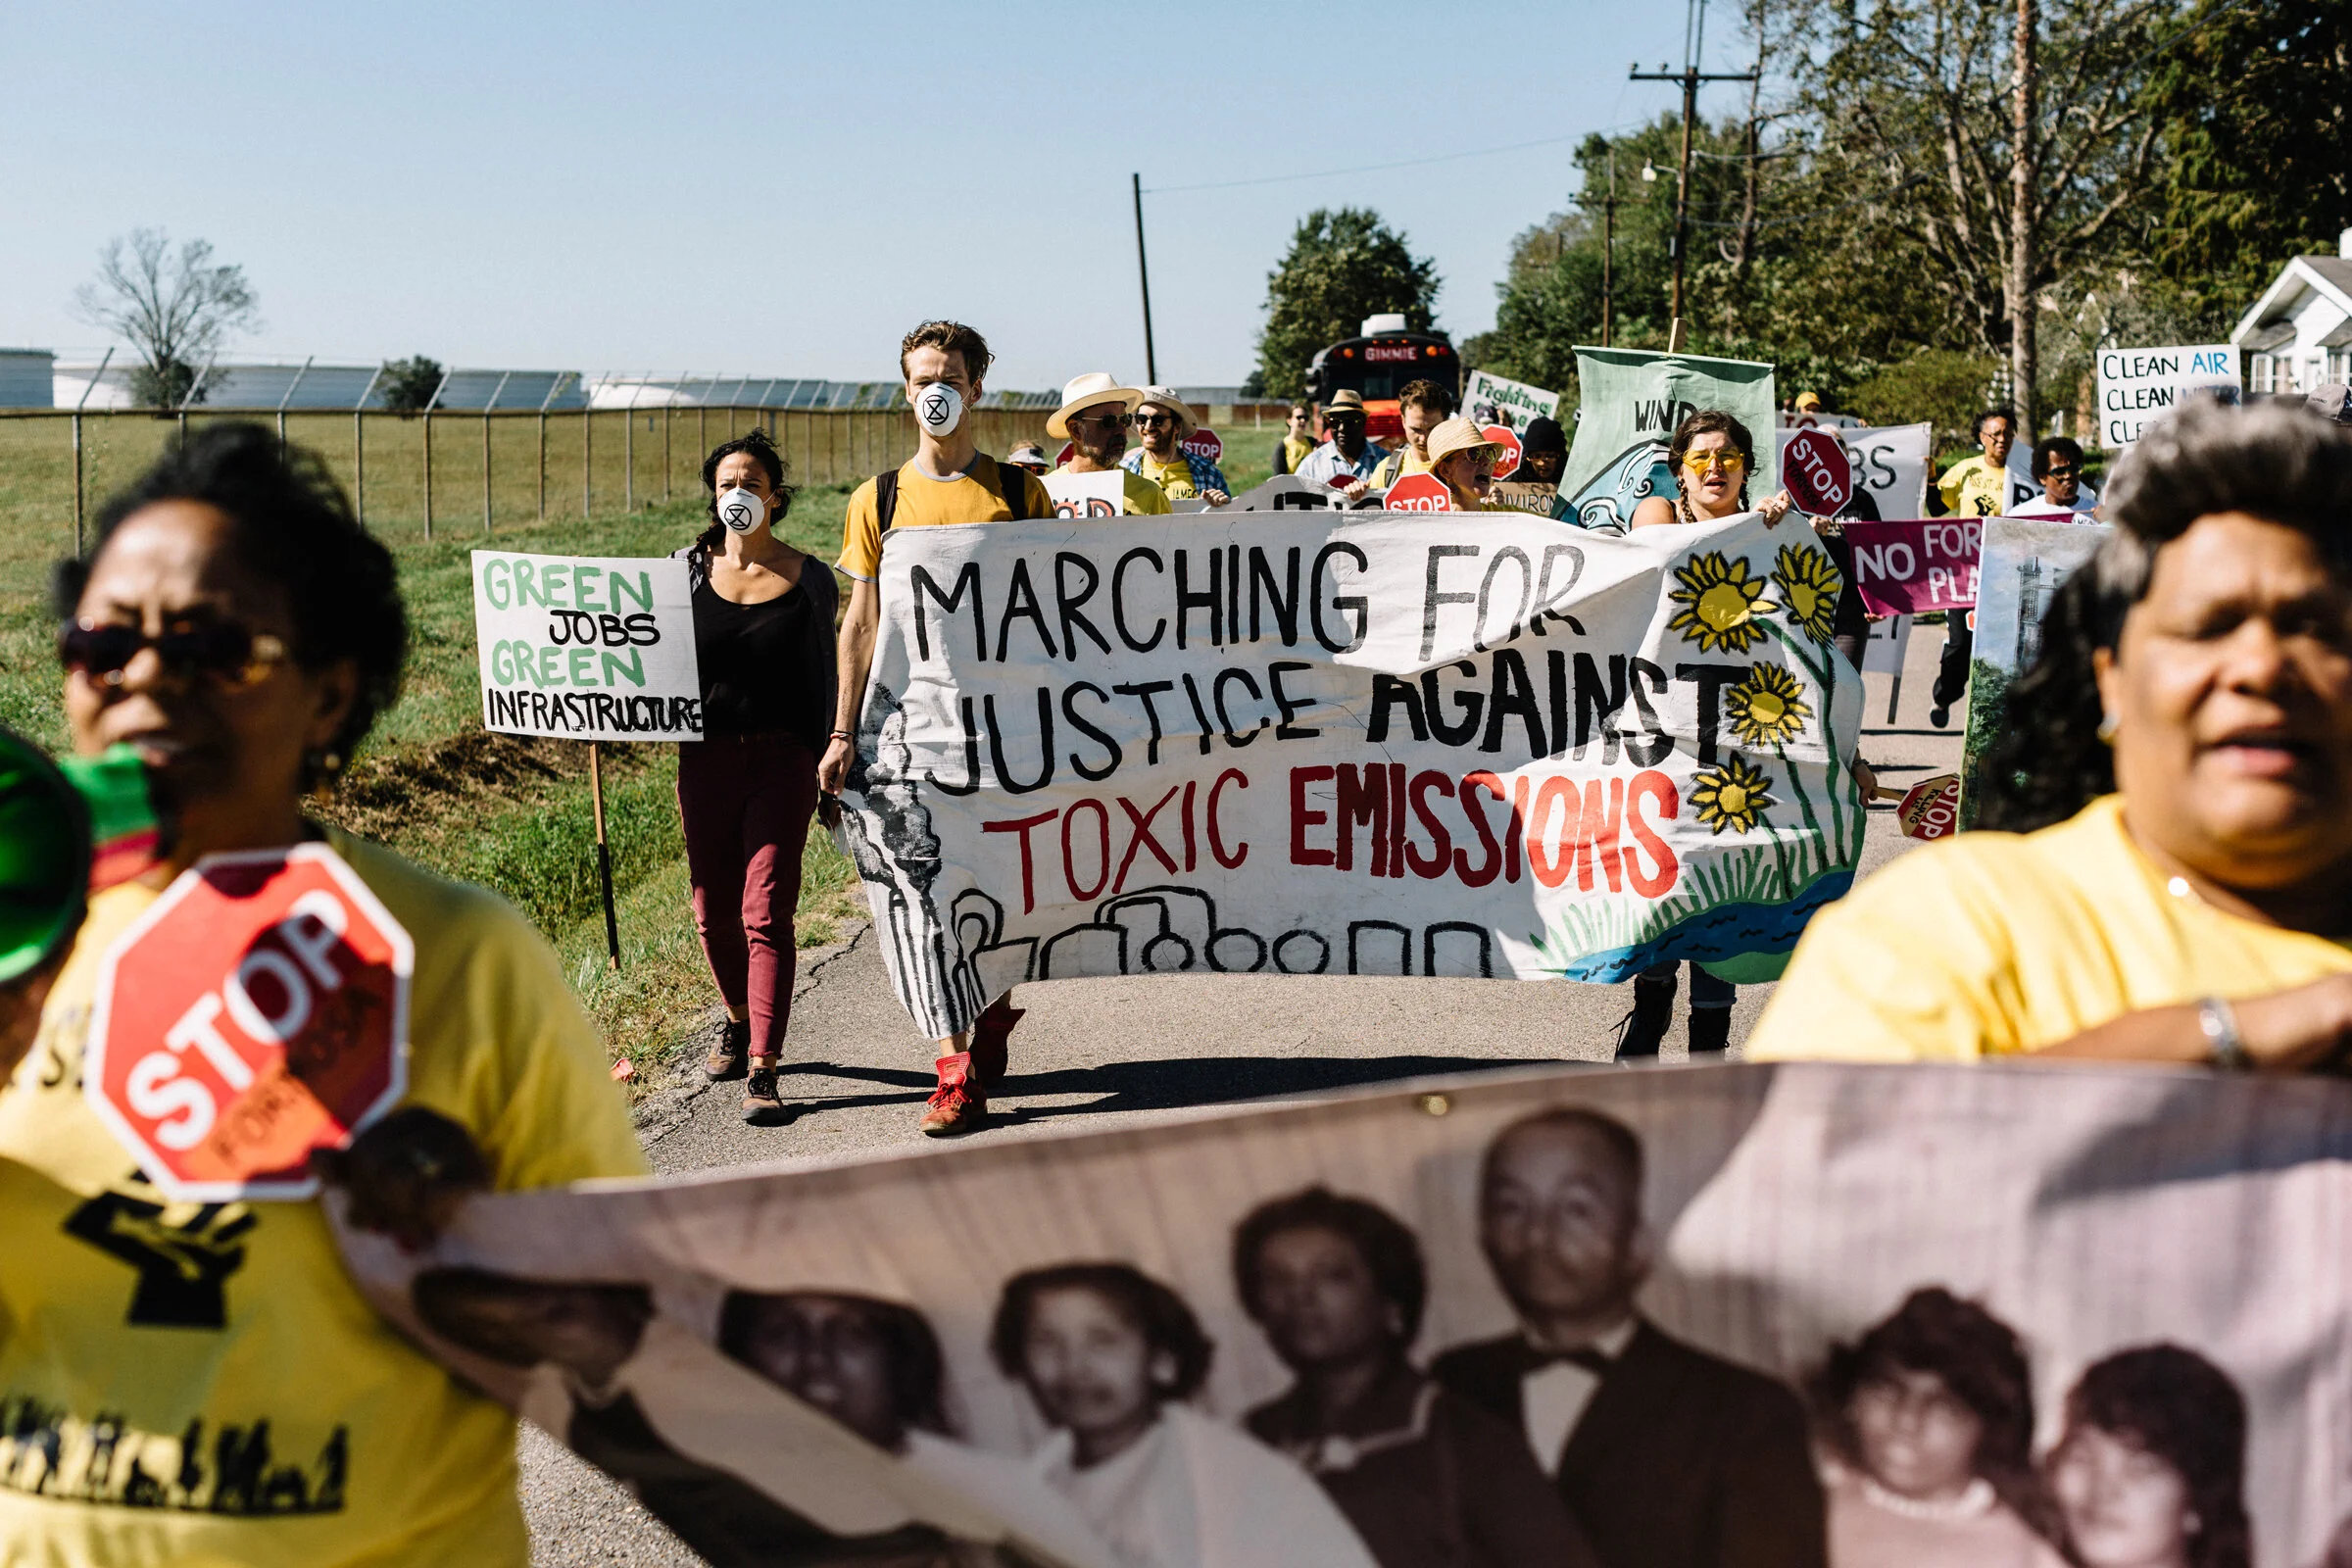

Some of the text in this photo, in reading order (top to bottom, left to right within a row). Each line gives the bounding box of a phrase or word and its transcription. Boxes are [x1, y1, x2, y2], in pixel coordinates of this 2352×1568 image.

[1365, 347, 1417, 361] GINNIE
[2103, 352, 2230, 380] CLEAN AIR
[1477, 377, 1553, 416] Fighting
[1635, 400, 1698, 432] WIND
[2107, 386, 2174, 412] CLEAN
[1184, 442, 1220, 459] STOP
[2110, 420, 2145, 444] CLE
[1792, 438, 1843, 504] STOP
[1390, 494, 1447, 513] STOP
[1854, 542, 1916, 583] NO
[483, 559, 654, 615] GREEN
[909, 541, 1588, 662] MARCHING FOR
[549, 610, 662, 647] JOBS
[492, 639, 646, 689] GREEN
[488, 688, 703, 733] INFRASTRUCTURE
[924, 649, 1753, 796] JUSTICE AGAINST
[1920, 784, 1960, 839] STOP
[981, 761, 1680, 915] TOXIC EMISSIONS
[125, 888, 349, 1152] STOP
